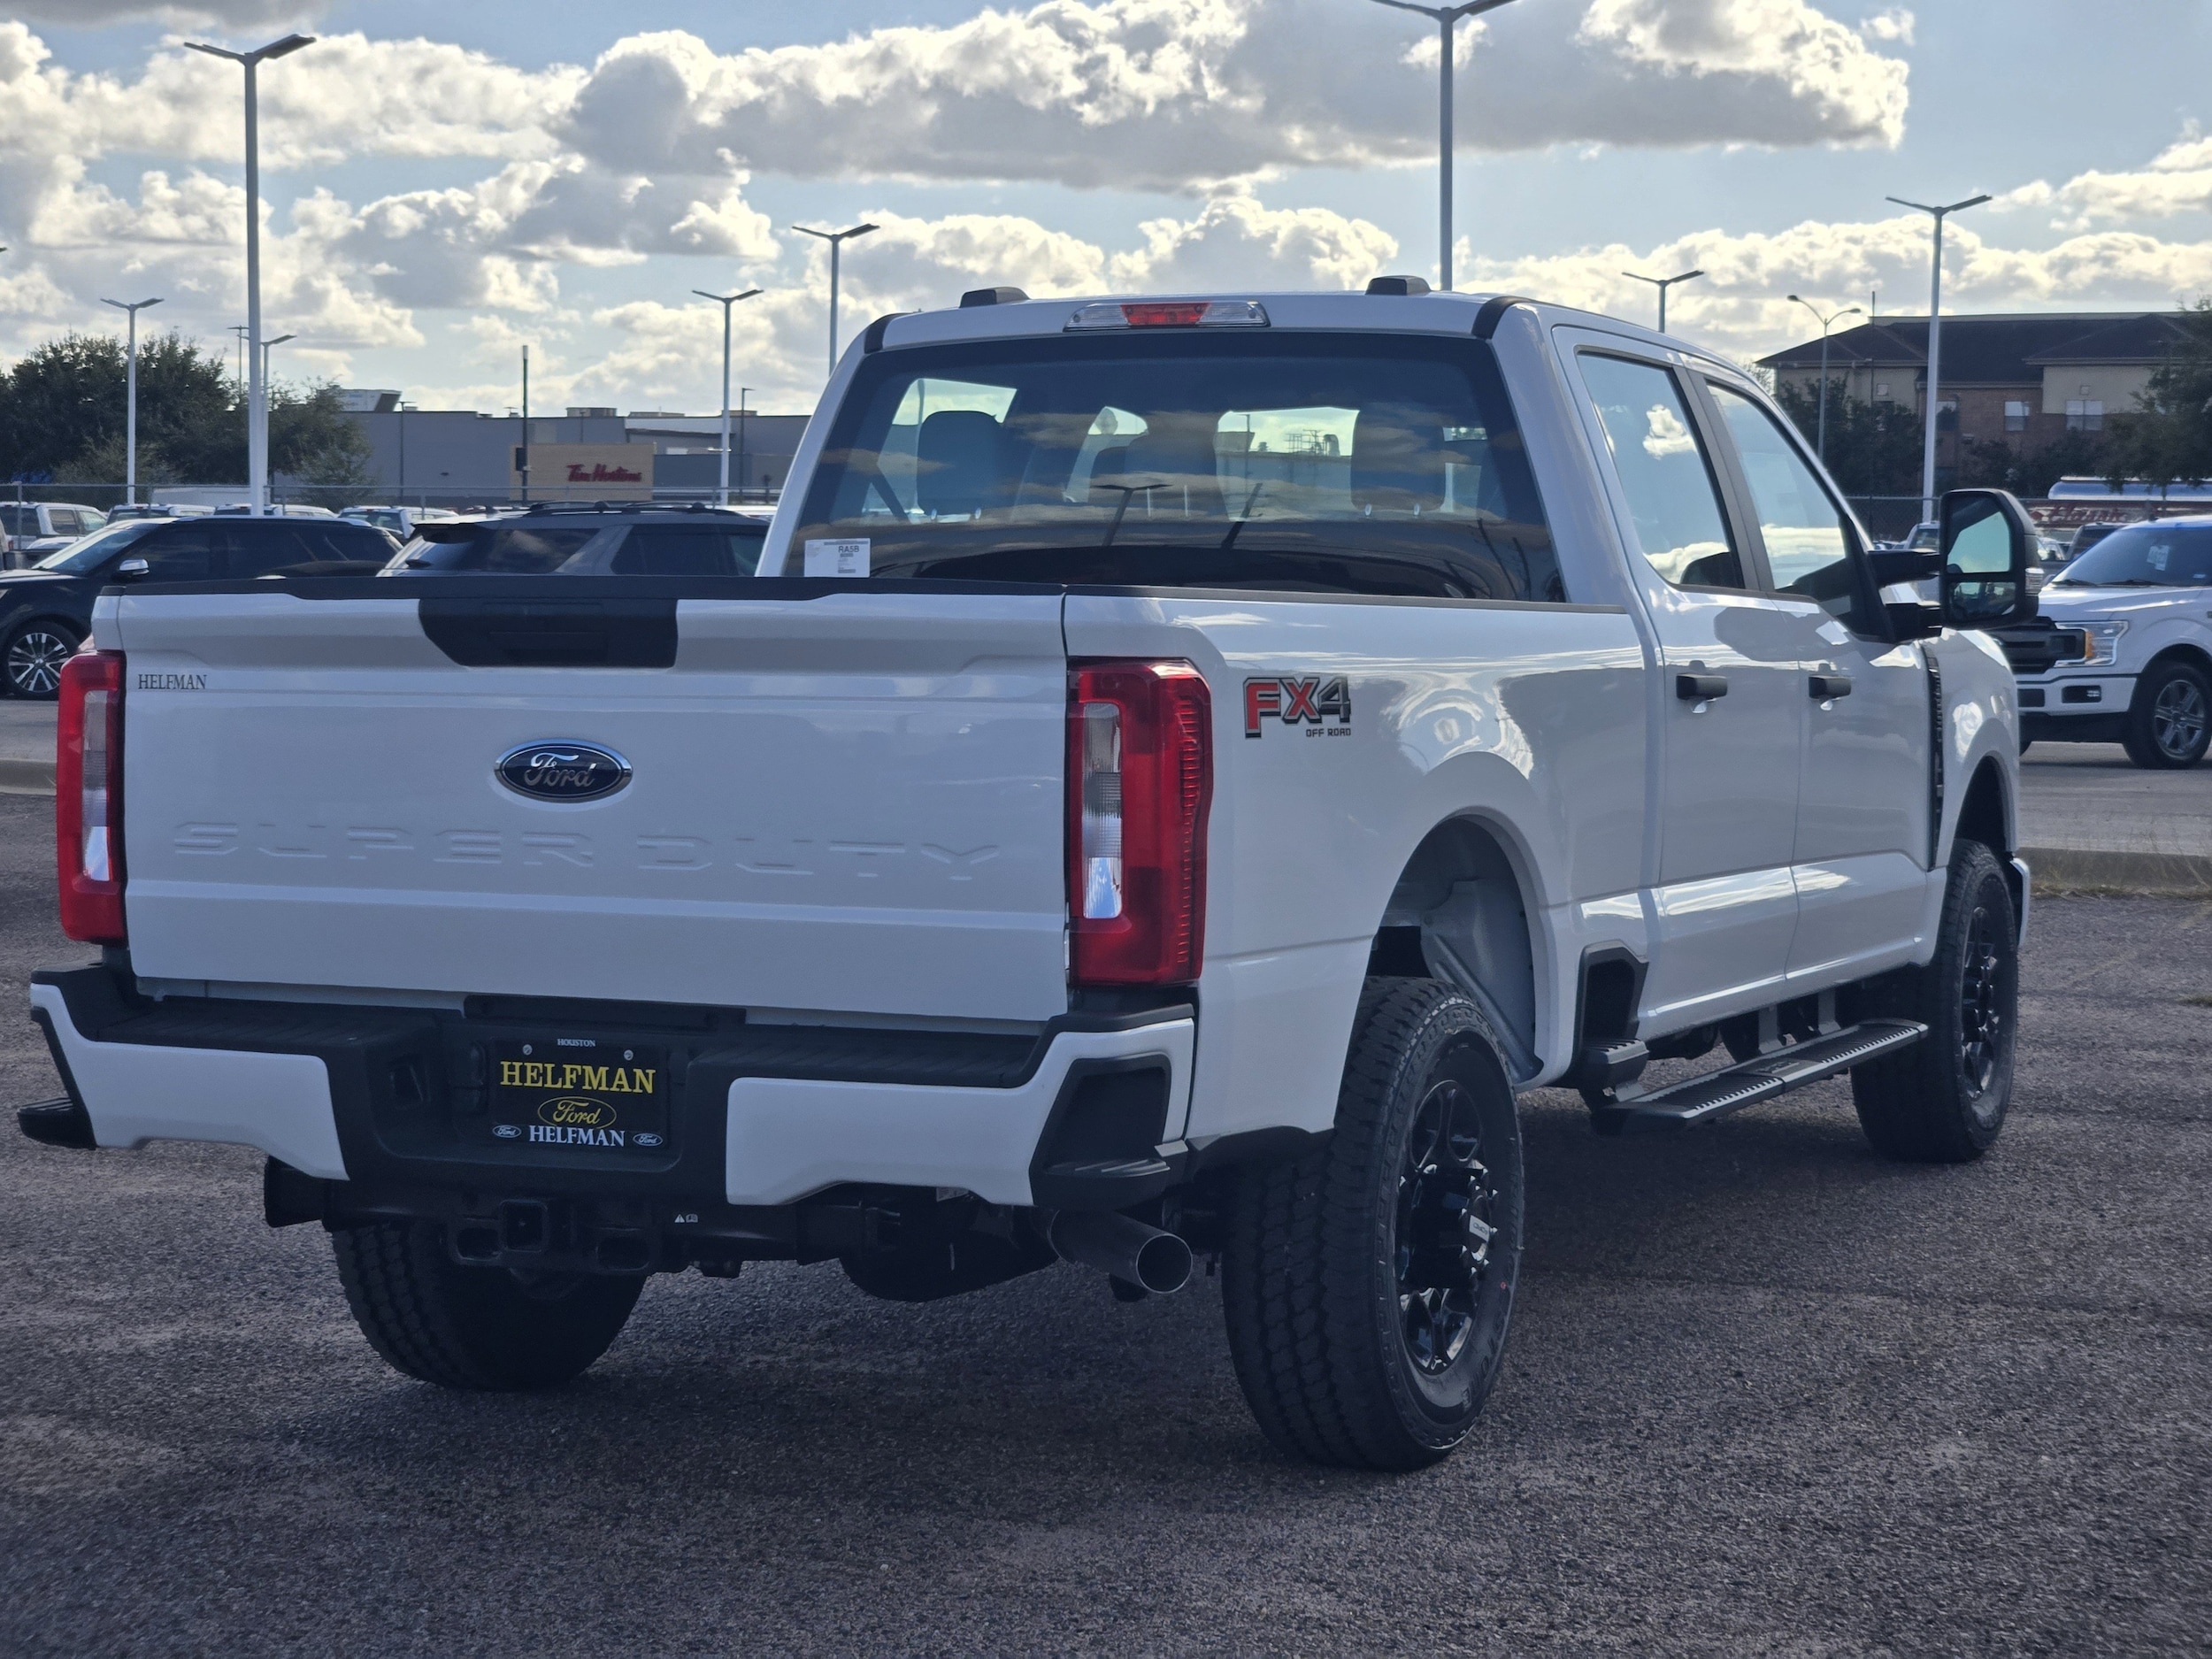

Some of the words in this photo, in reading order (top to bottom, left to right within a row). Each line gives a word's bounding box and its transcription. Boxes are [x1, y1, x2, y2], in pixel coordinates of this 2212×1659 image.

[565, 464, 590, 482] Tim
[591, 463, 642, 482] Hortons
[138, 673, 207, 689] HELFMAN
[1243, 676, 1351, 739] FX4
[1305, 727, 1325, 737] OFF
[1327, 727, 1352, 737] ROAD
[524, 752, 597, 787] Ford
[174, 821, 594, 867] SUPER
[635, 834, 1001, 881] DUTY
[557, 1038, 596, 1048] HOUSTON
[500, 1060, 657, 1094] HELFMAN
[552, 1100, 602, 1125] Ford
[528, 1125, 626, 1147] HELFMAN
